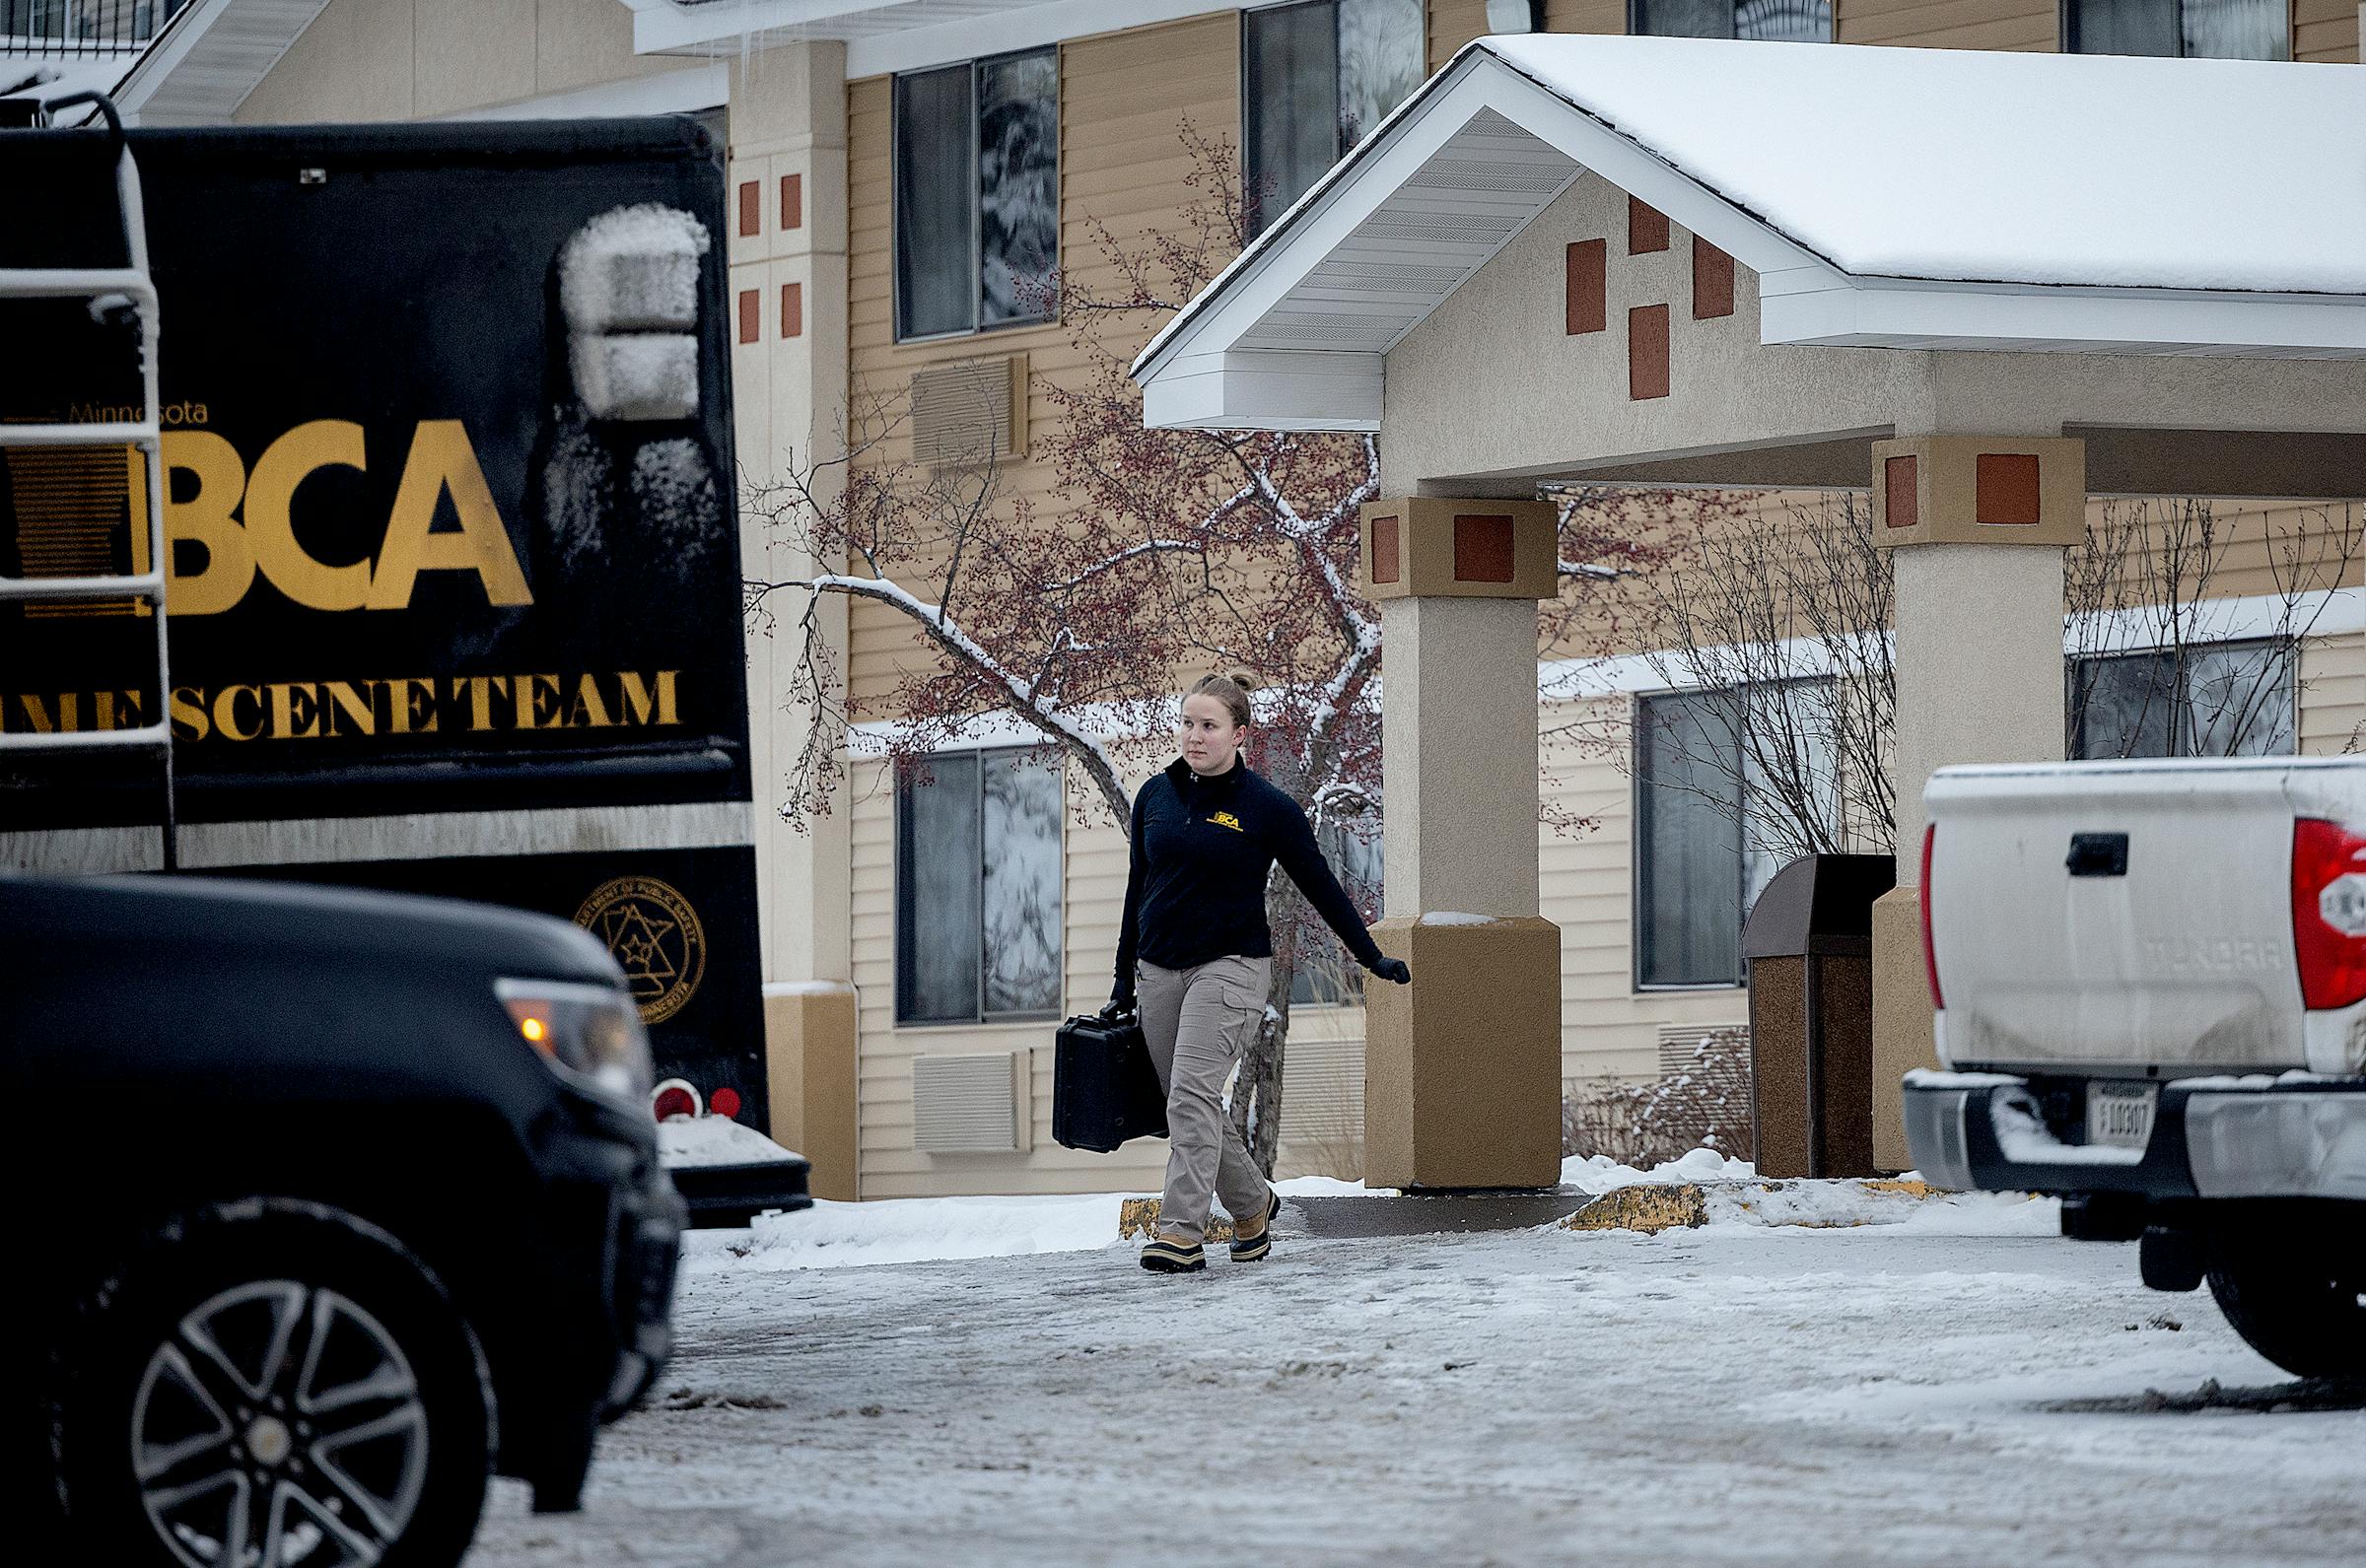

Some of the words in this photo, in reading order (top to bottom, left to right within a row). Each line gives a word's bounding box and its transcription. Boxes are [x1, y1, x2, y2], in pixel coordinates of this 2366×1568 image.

[158, 419, 534, 616] BCA
[170, 677, 439, 741] SCENE
[452, 670, 684, 731] TEAM
[1218, 814, 1239, 828] BCA
